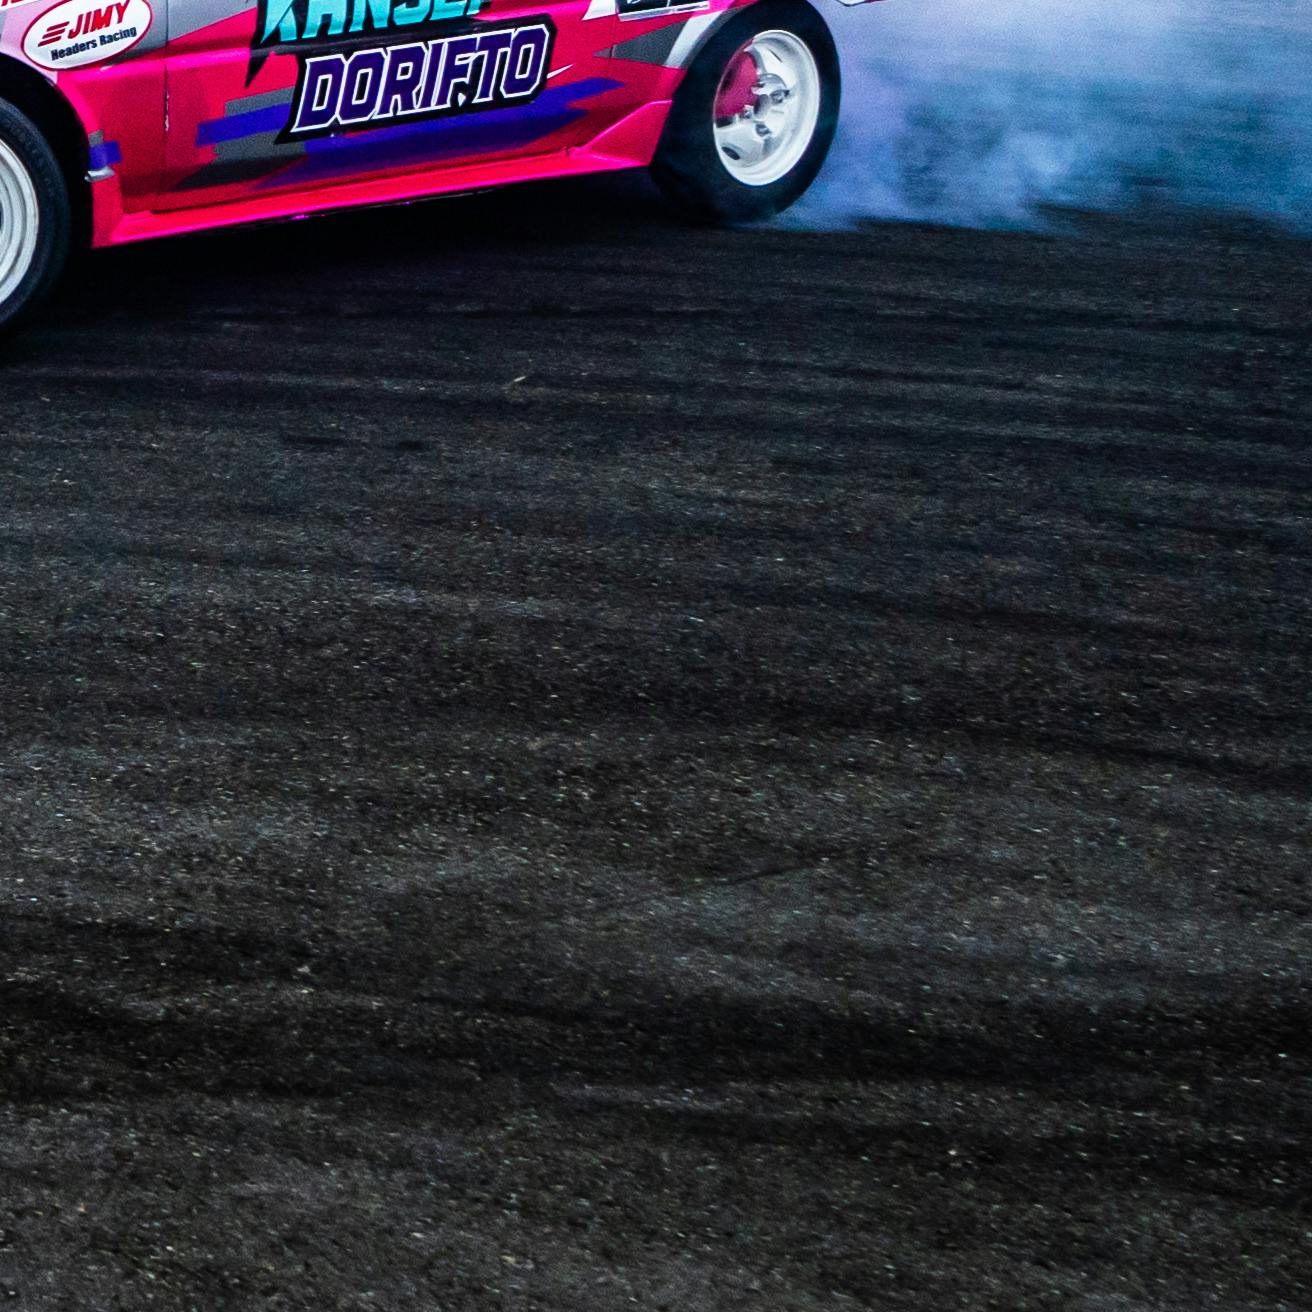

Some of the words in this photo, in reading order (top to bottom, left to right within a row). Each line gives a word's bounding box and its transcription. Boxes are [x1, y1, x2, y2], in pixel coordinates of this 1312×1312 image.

[68, 0, 131, 39] JIMY
[51, 41, 98, 61] Headers
[99, 26, 137, 46] Racing
[290, 24, 549, 133] DORIFTO
